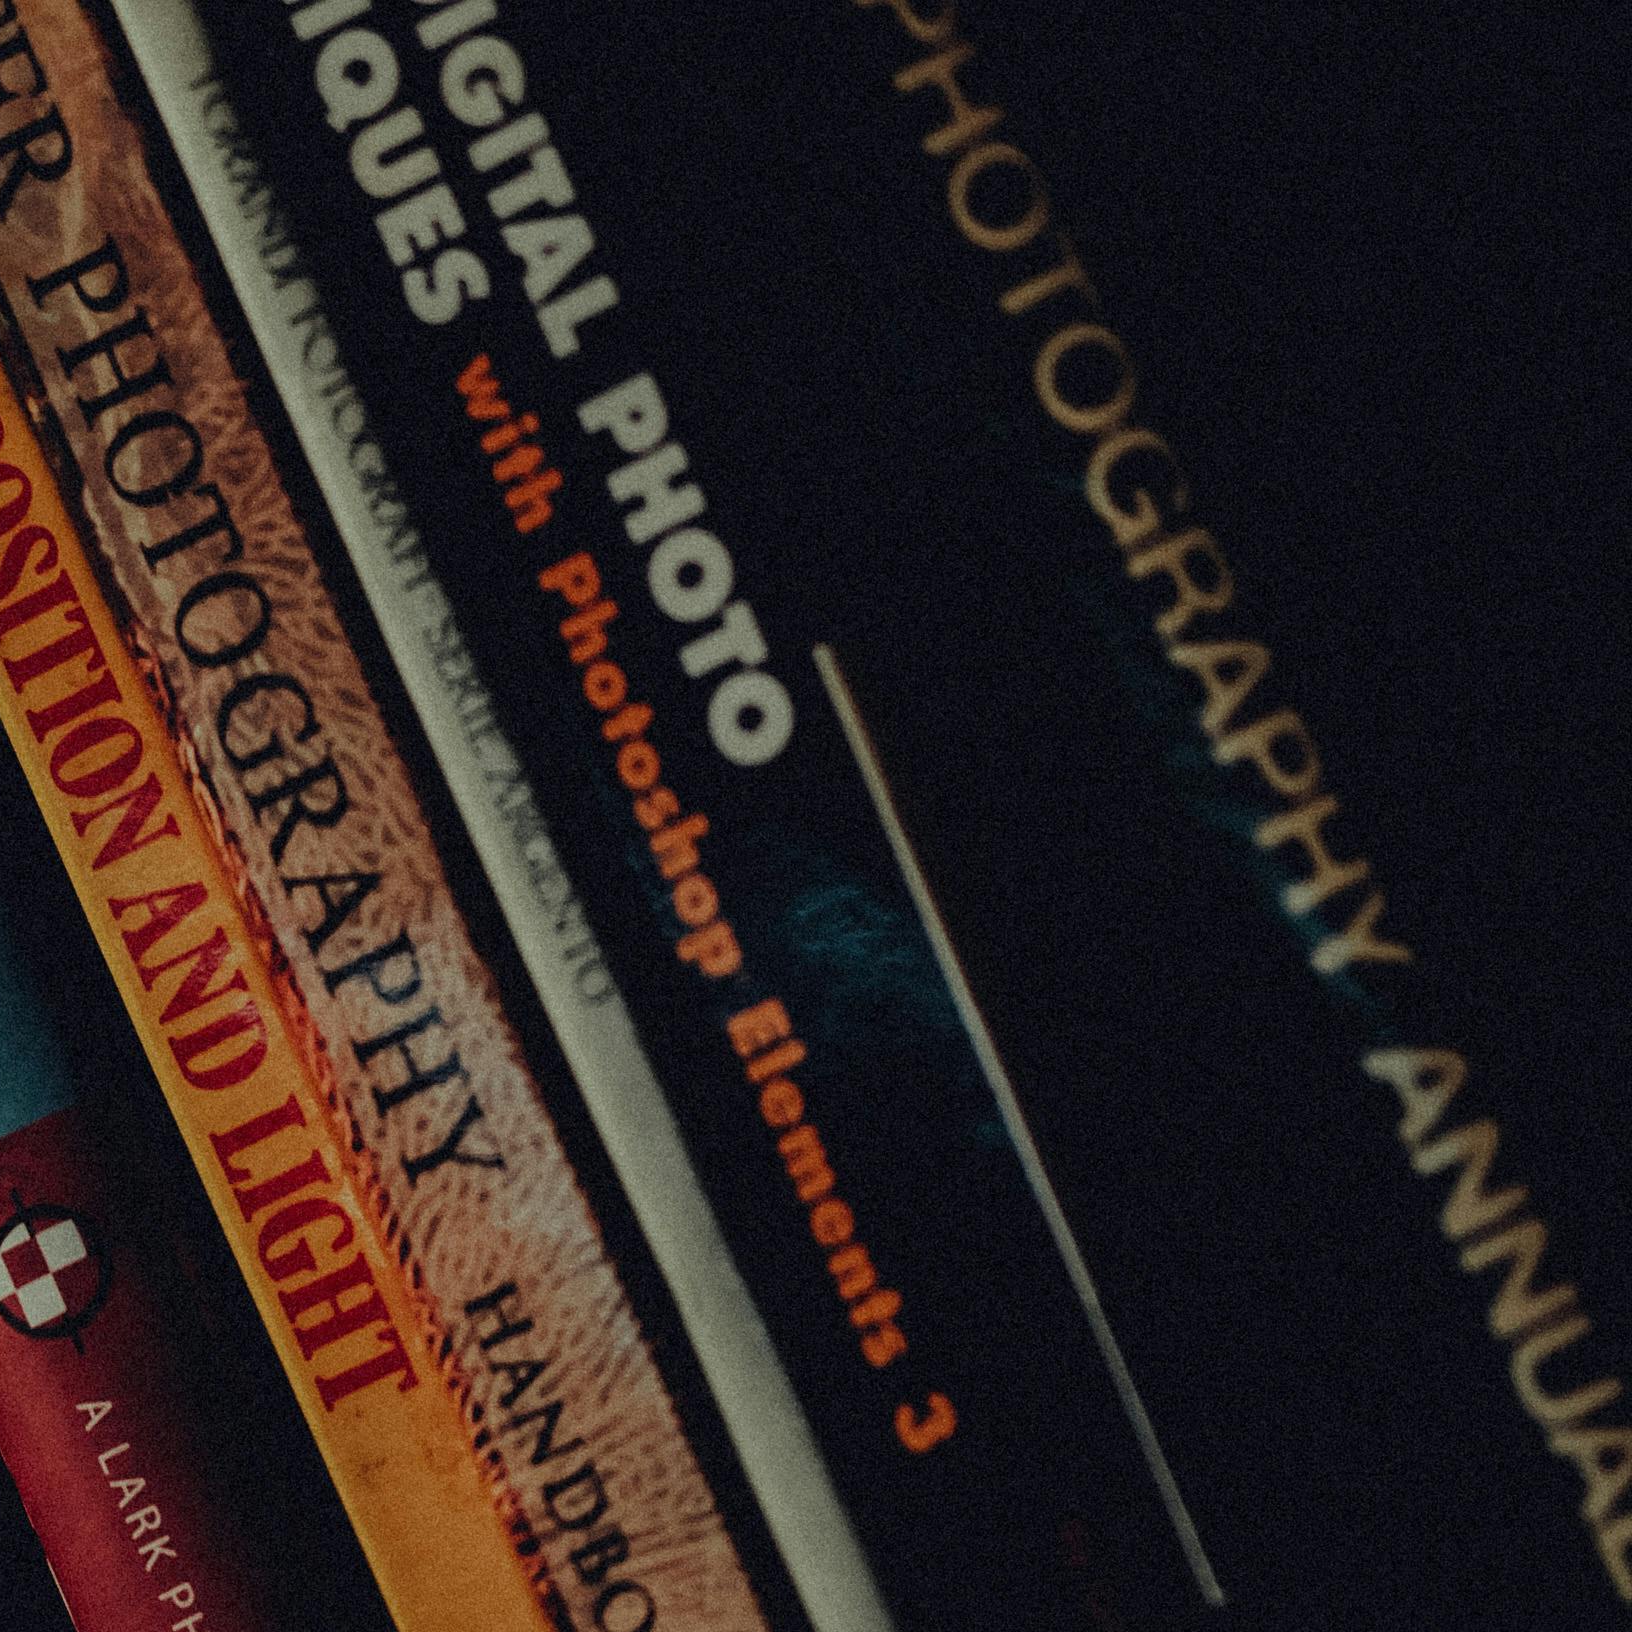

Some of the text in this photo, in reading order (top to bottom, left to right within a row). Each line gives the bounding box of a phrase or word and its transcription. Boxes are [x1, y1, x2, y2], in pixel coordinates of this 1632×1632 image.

[28, 235, 505, 1187] PHOTOGRAPHY
[284, 0, 958, 1454] IQUES with Photoshop Elements 3
[413, 0, 797, 767] IGITAL PHOTO
[75, 1398, 114, 1436] A
[97, 1441, 180, 1574] LARK
[109, 881, 269, 1092] AND
[210, 1093, 421, 1414] LIGHT
